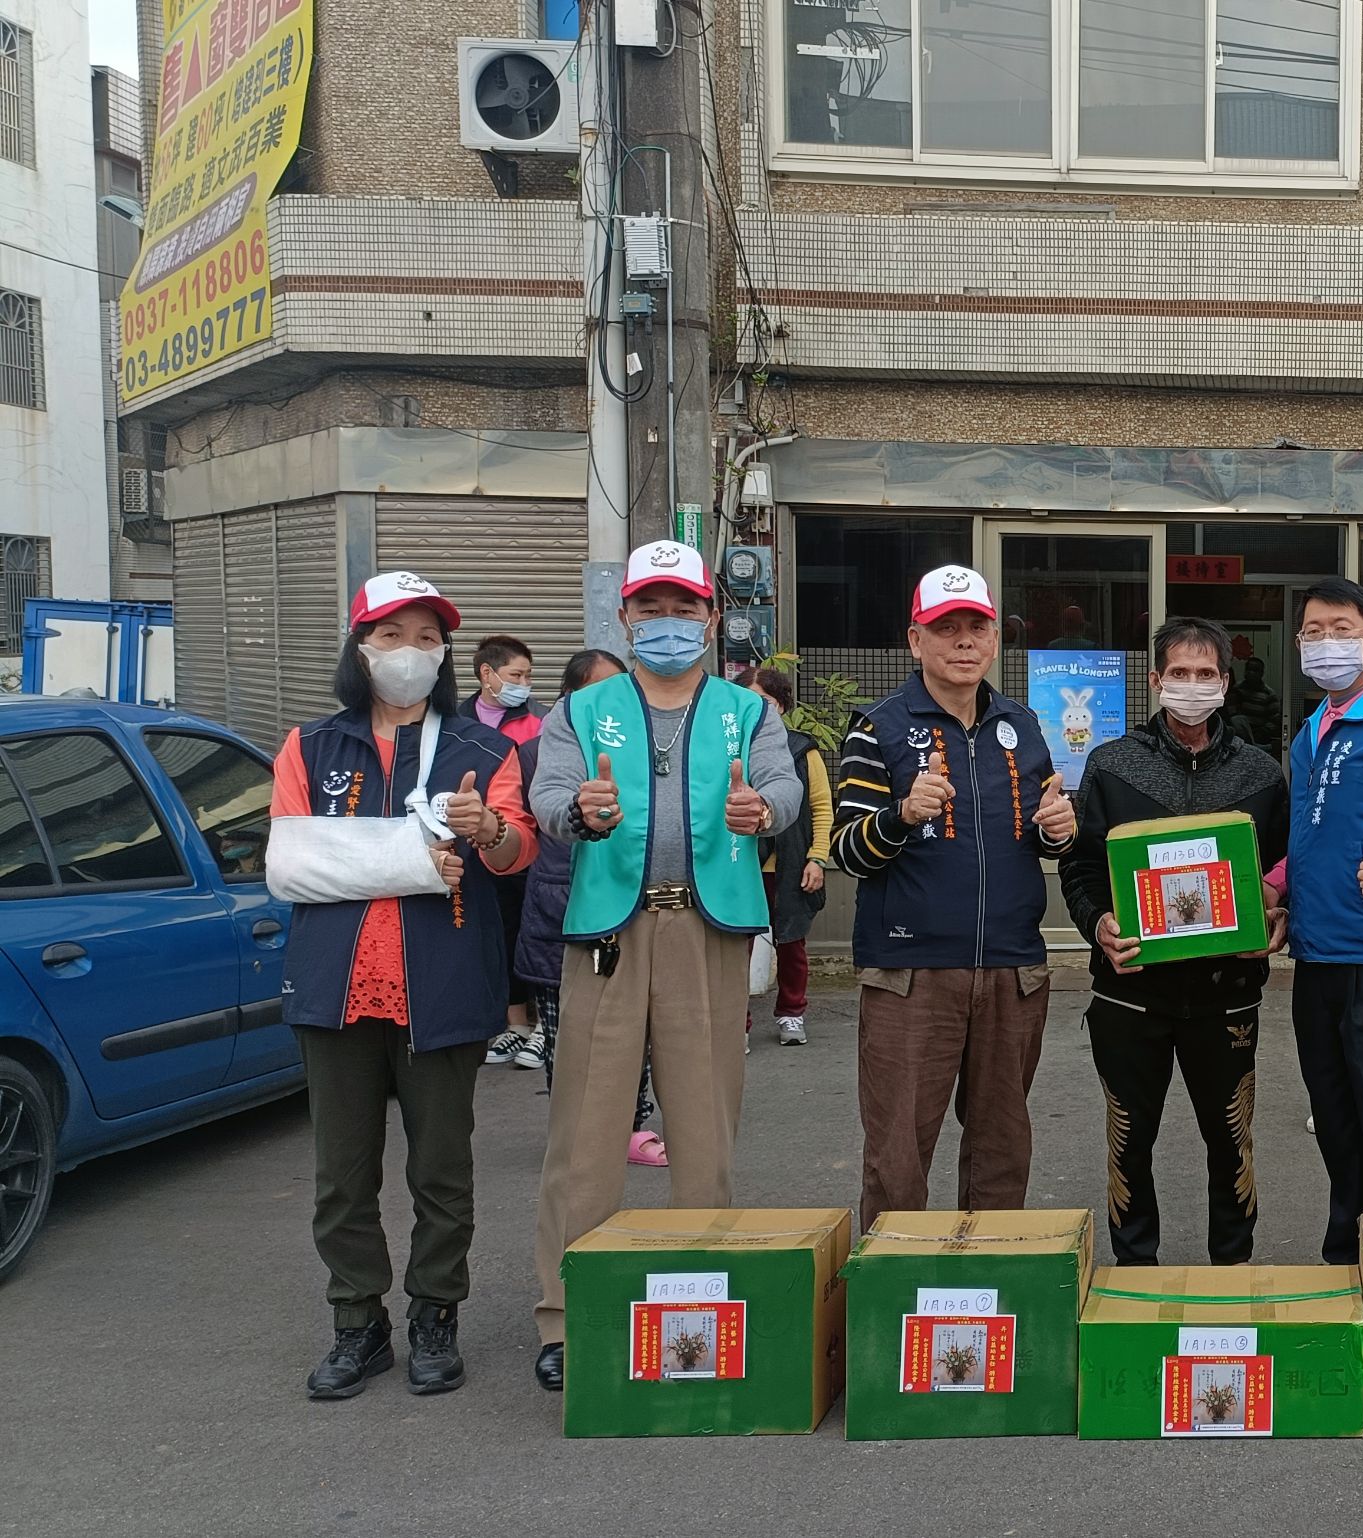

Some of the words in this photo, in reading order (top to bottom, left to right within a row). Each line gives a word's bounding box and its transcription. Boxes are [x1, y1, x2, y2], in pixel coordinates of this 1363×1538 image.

[125, 229, 265, 346] 0937-118806
[126, 287, 267, 392] 03-4899777
[1034, 664, 1069, 676] TRAVEL
[1079, 667, 1120, 678] LONGTAN
[592, 714, 627, 748] 志
[1154, 849, 1195, 863] 1月13日
[652, 1282, 696, 1297] 1月13日
[923, 1299, 969, 1312] 1月13日
[1184, 1338, 1229, 1351] 1月13日
